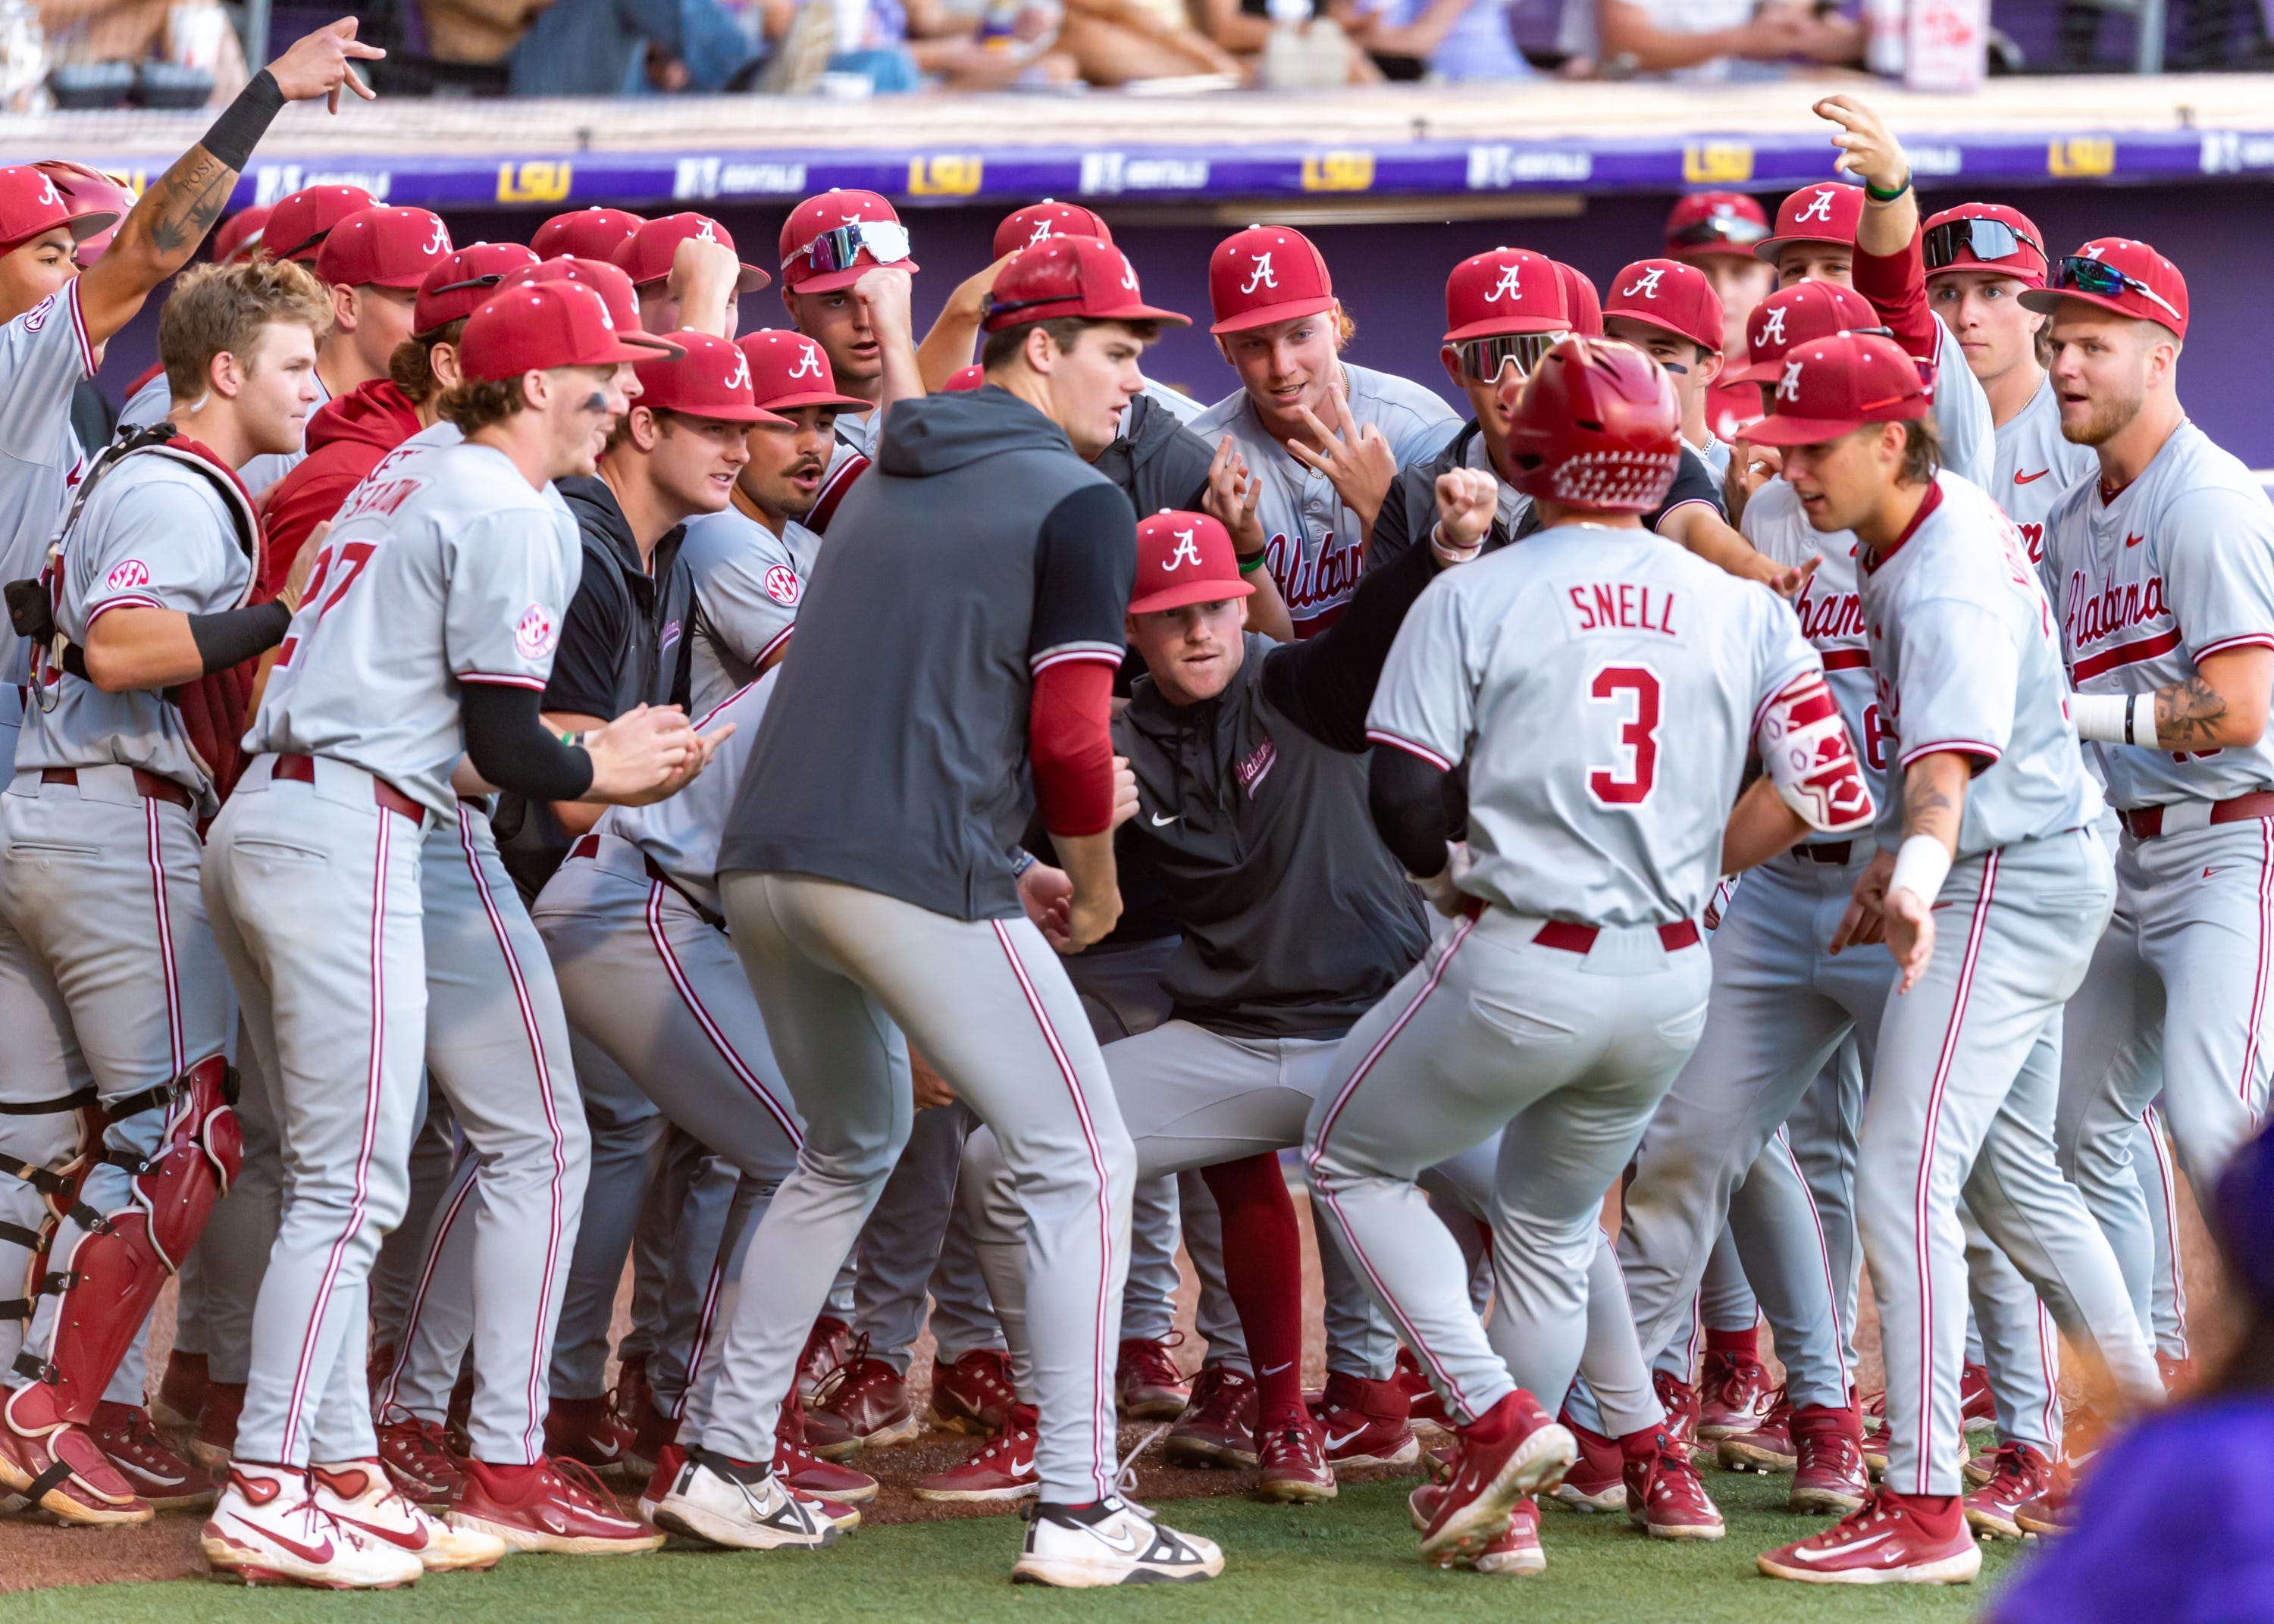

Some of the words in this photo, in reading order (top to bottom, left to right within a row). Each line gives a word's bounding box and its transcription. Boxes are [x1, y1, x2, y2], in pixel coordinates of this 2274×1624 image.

[496, 161, 573, 202] LSU
[907, 155, 984, 196] LSU
[1300, 150, 1376, 192] LSU
[1683, 142, 1755, 183] LSU
[1794, 189, 1836, 223] A
[422, 211, 454, 255] A
[1241, 252, 1278, 294] A
[1484, 264, 1522, 302] A
[1623, 266, 1665, 299] A
[1755, 306, 1787, 348] A
[724, 345, 753, 391] A
[788, 343, 823, 378] A
[1775, 361, 1804, 403] A
[1162, 528, 1202, 571] A
[766, 565, 798, 603] SEC
[1568, 583, 1676, 637] SNELL
[1587, 663, 1663, 807] 3
